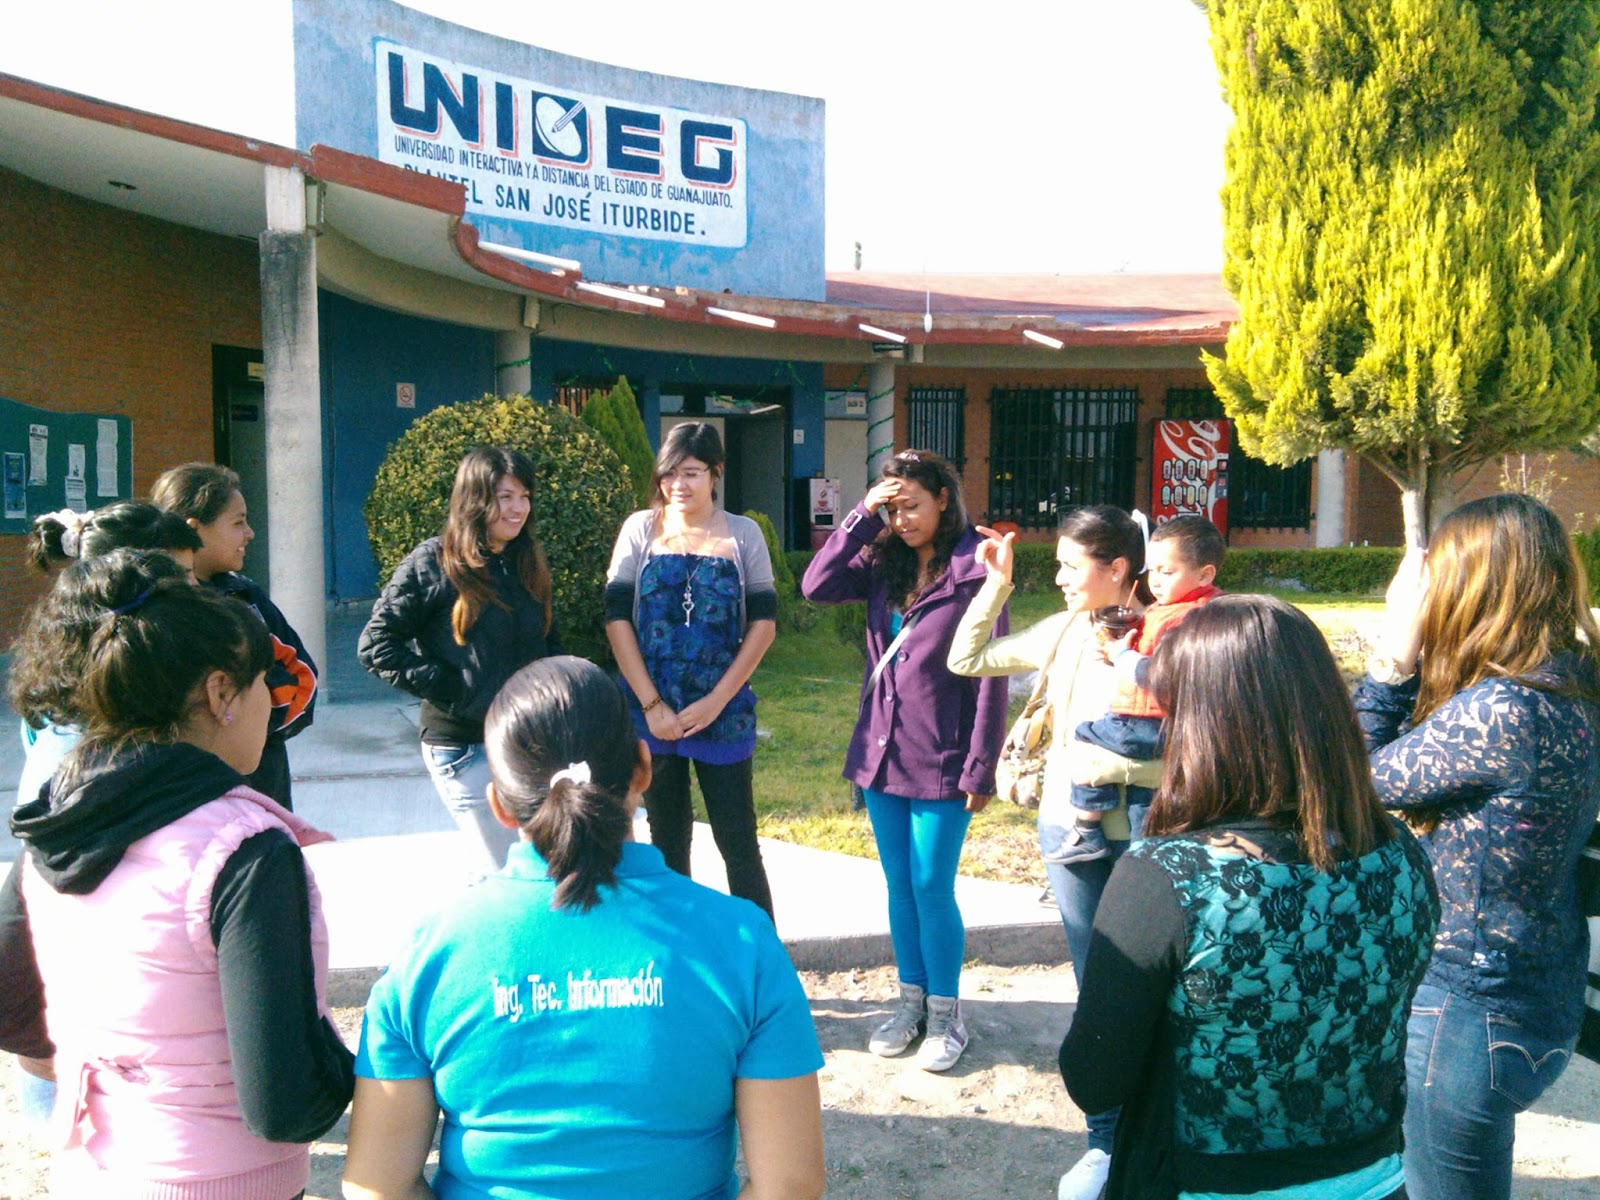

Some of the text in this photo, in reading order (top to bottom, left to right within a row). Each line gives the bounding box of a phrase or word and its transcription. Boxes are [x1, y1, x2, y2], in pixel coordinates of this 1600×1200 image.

[395, 135, 455, 164] UNIVERSIDAD
[459, 150, 523, 177] INTERACTIVA
[542, 165, 590, 189] DISTANCIA
[594, 174, 611, 193] DEL
[615, 177, 648, 197] ESTADO
[651, 182, 663, 199] DE
[667, 185, 733, 208] GUANAJUATO.
[495, 184, 706, 235] SAN JOSÉ ITURBIDE.
[527, 974, 561, 1014] Tec.
[568, 960, 664, 1011] Información
